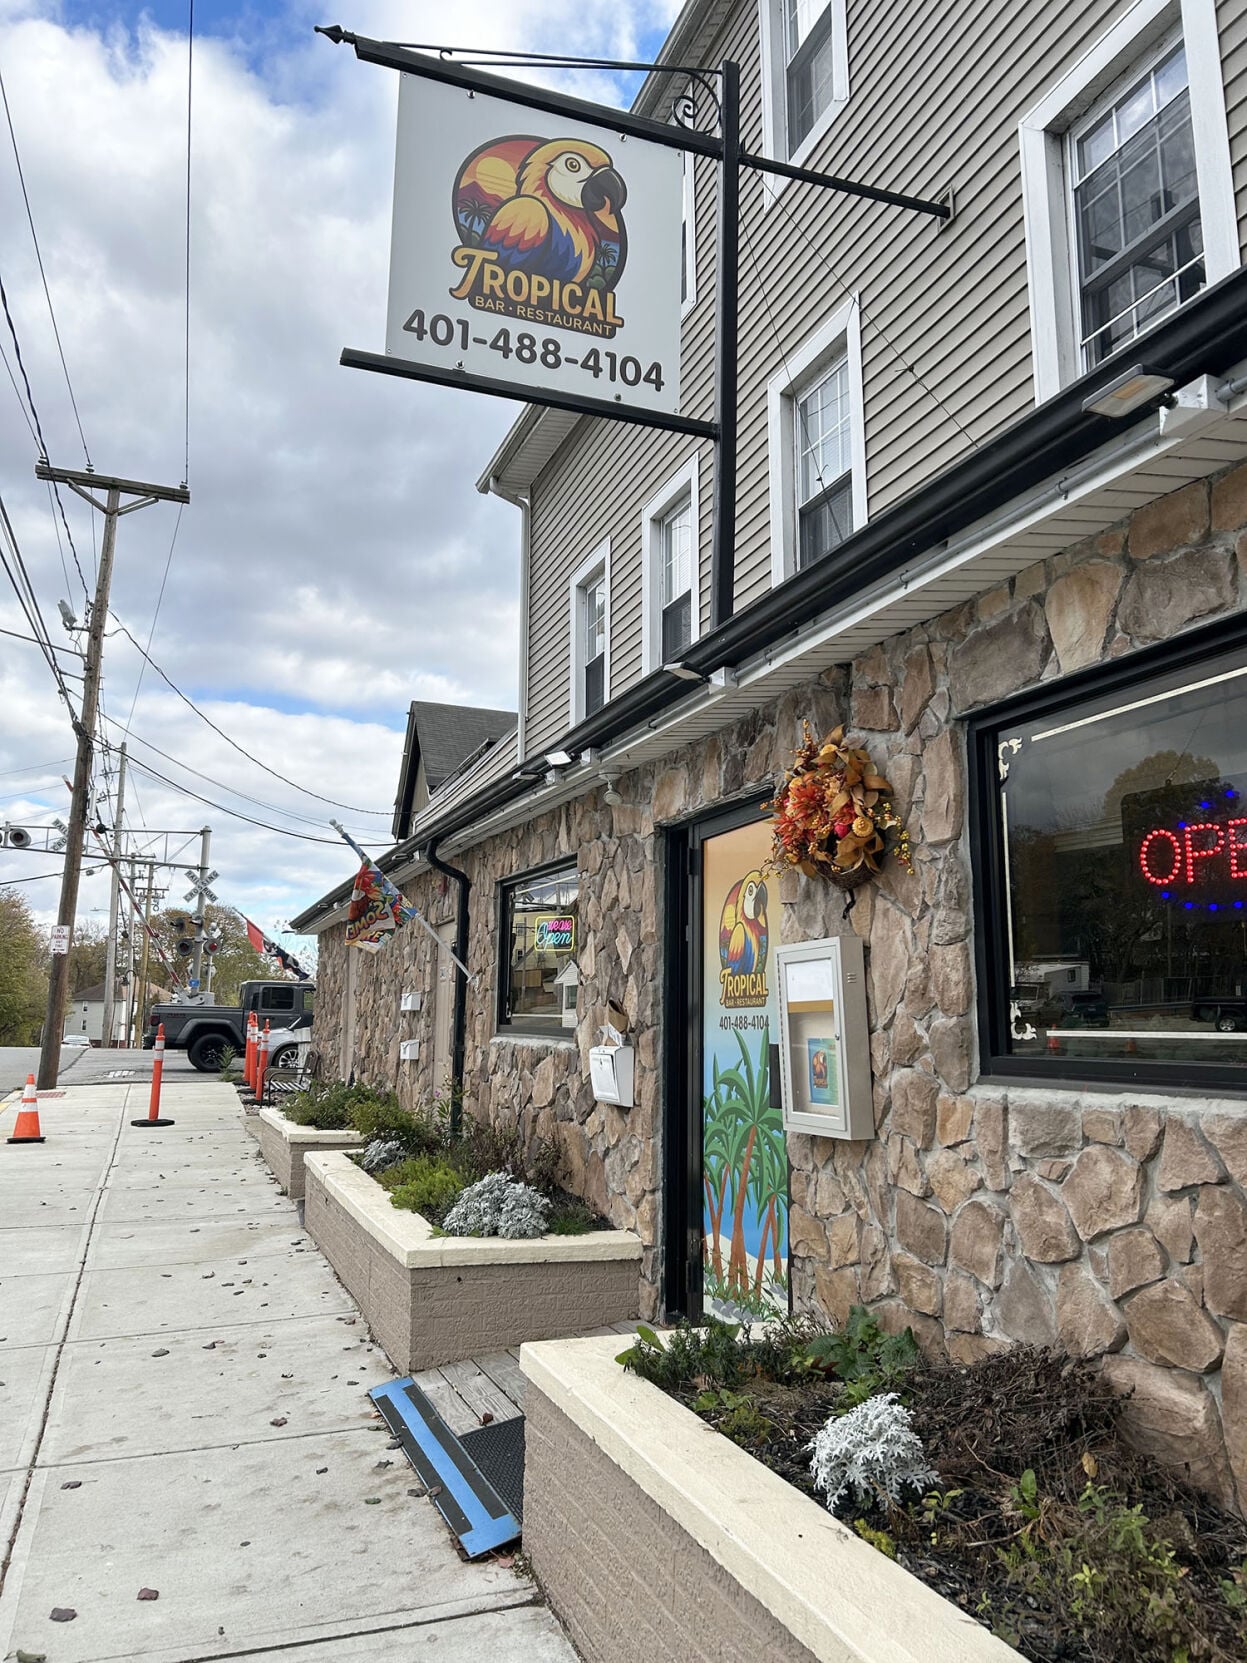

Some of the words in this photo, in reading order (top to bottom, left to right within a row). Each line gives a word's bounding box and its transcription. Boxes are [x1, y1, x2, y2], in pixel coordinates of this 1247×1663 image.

[450, 247, 623, 325] TROPICAL
[475, 296, 505, 313] BAR
[516, 304, 613, 337] RESTAURANT
[402, 309, 665, 392] 401-488-4104
[719, 967, 769, 1004] TROPICAL
[719, 1014, 770, 1031] 401-488-4104
